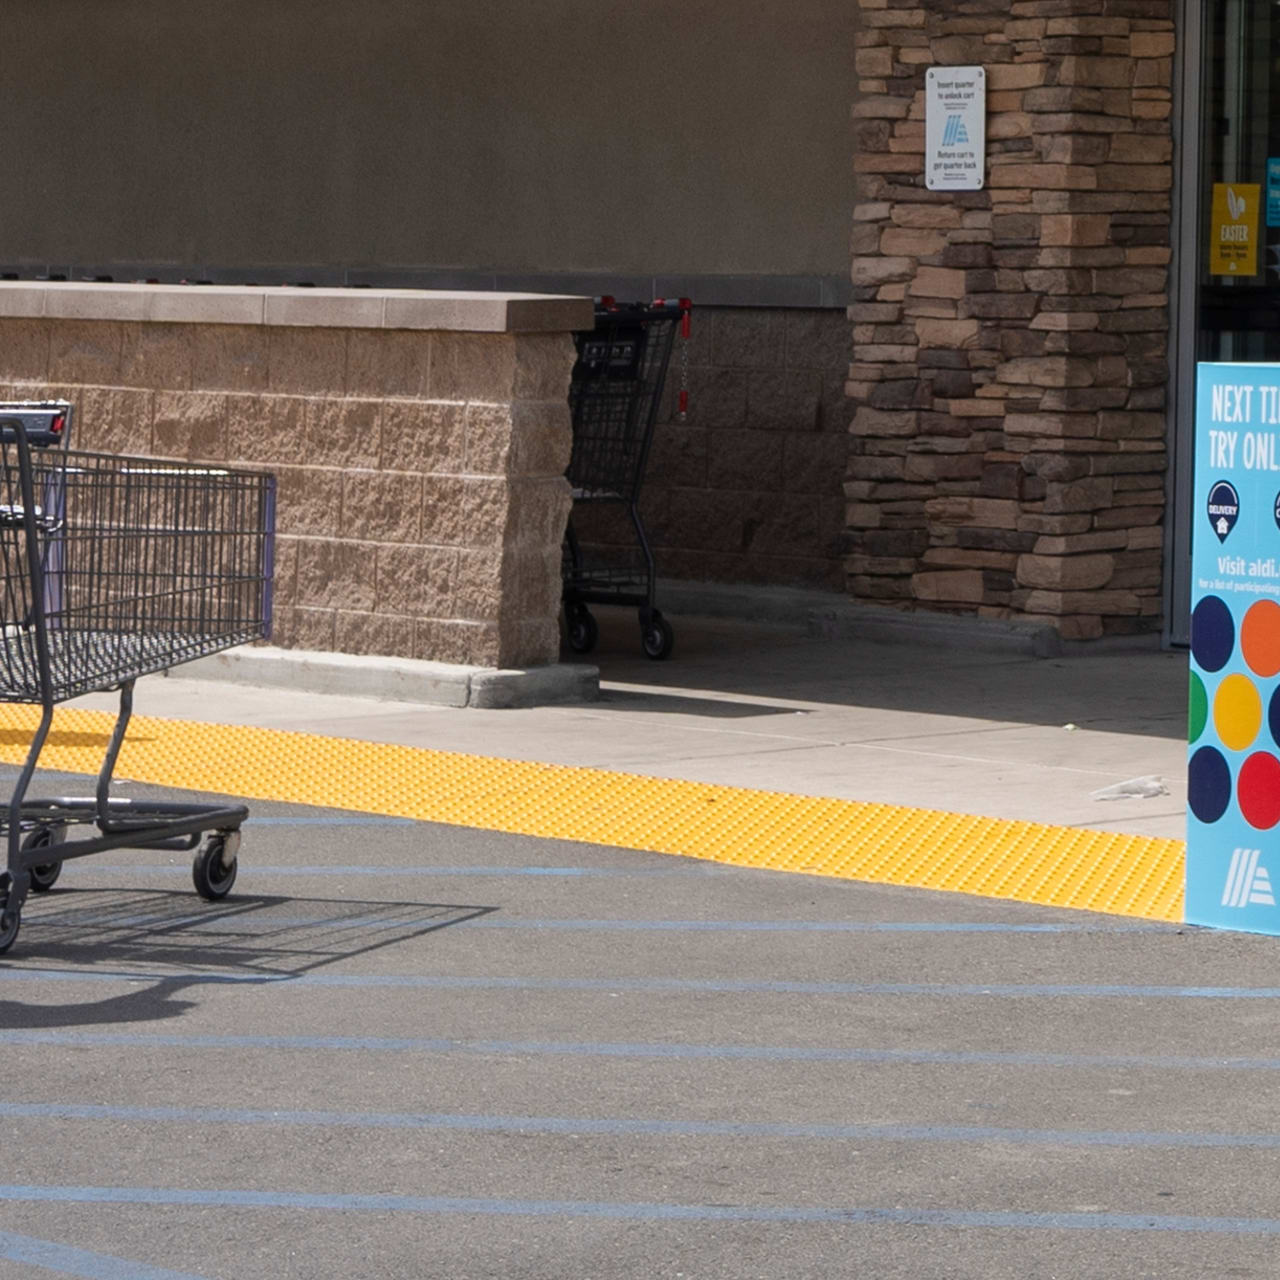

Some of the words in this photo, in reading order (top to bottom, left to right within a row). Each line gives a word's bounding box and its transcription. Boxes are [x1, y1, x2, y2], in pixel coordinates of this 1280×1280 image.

[1220, 223, 1249, 242] EASTER
[1211, 384, 1254, 423] NEXT
[1209, 430, 1237, 469] TRY
[1208, 504, 1238, 516] DELIVERY
[1217, 555, 1246, 576] Visit
